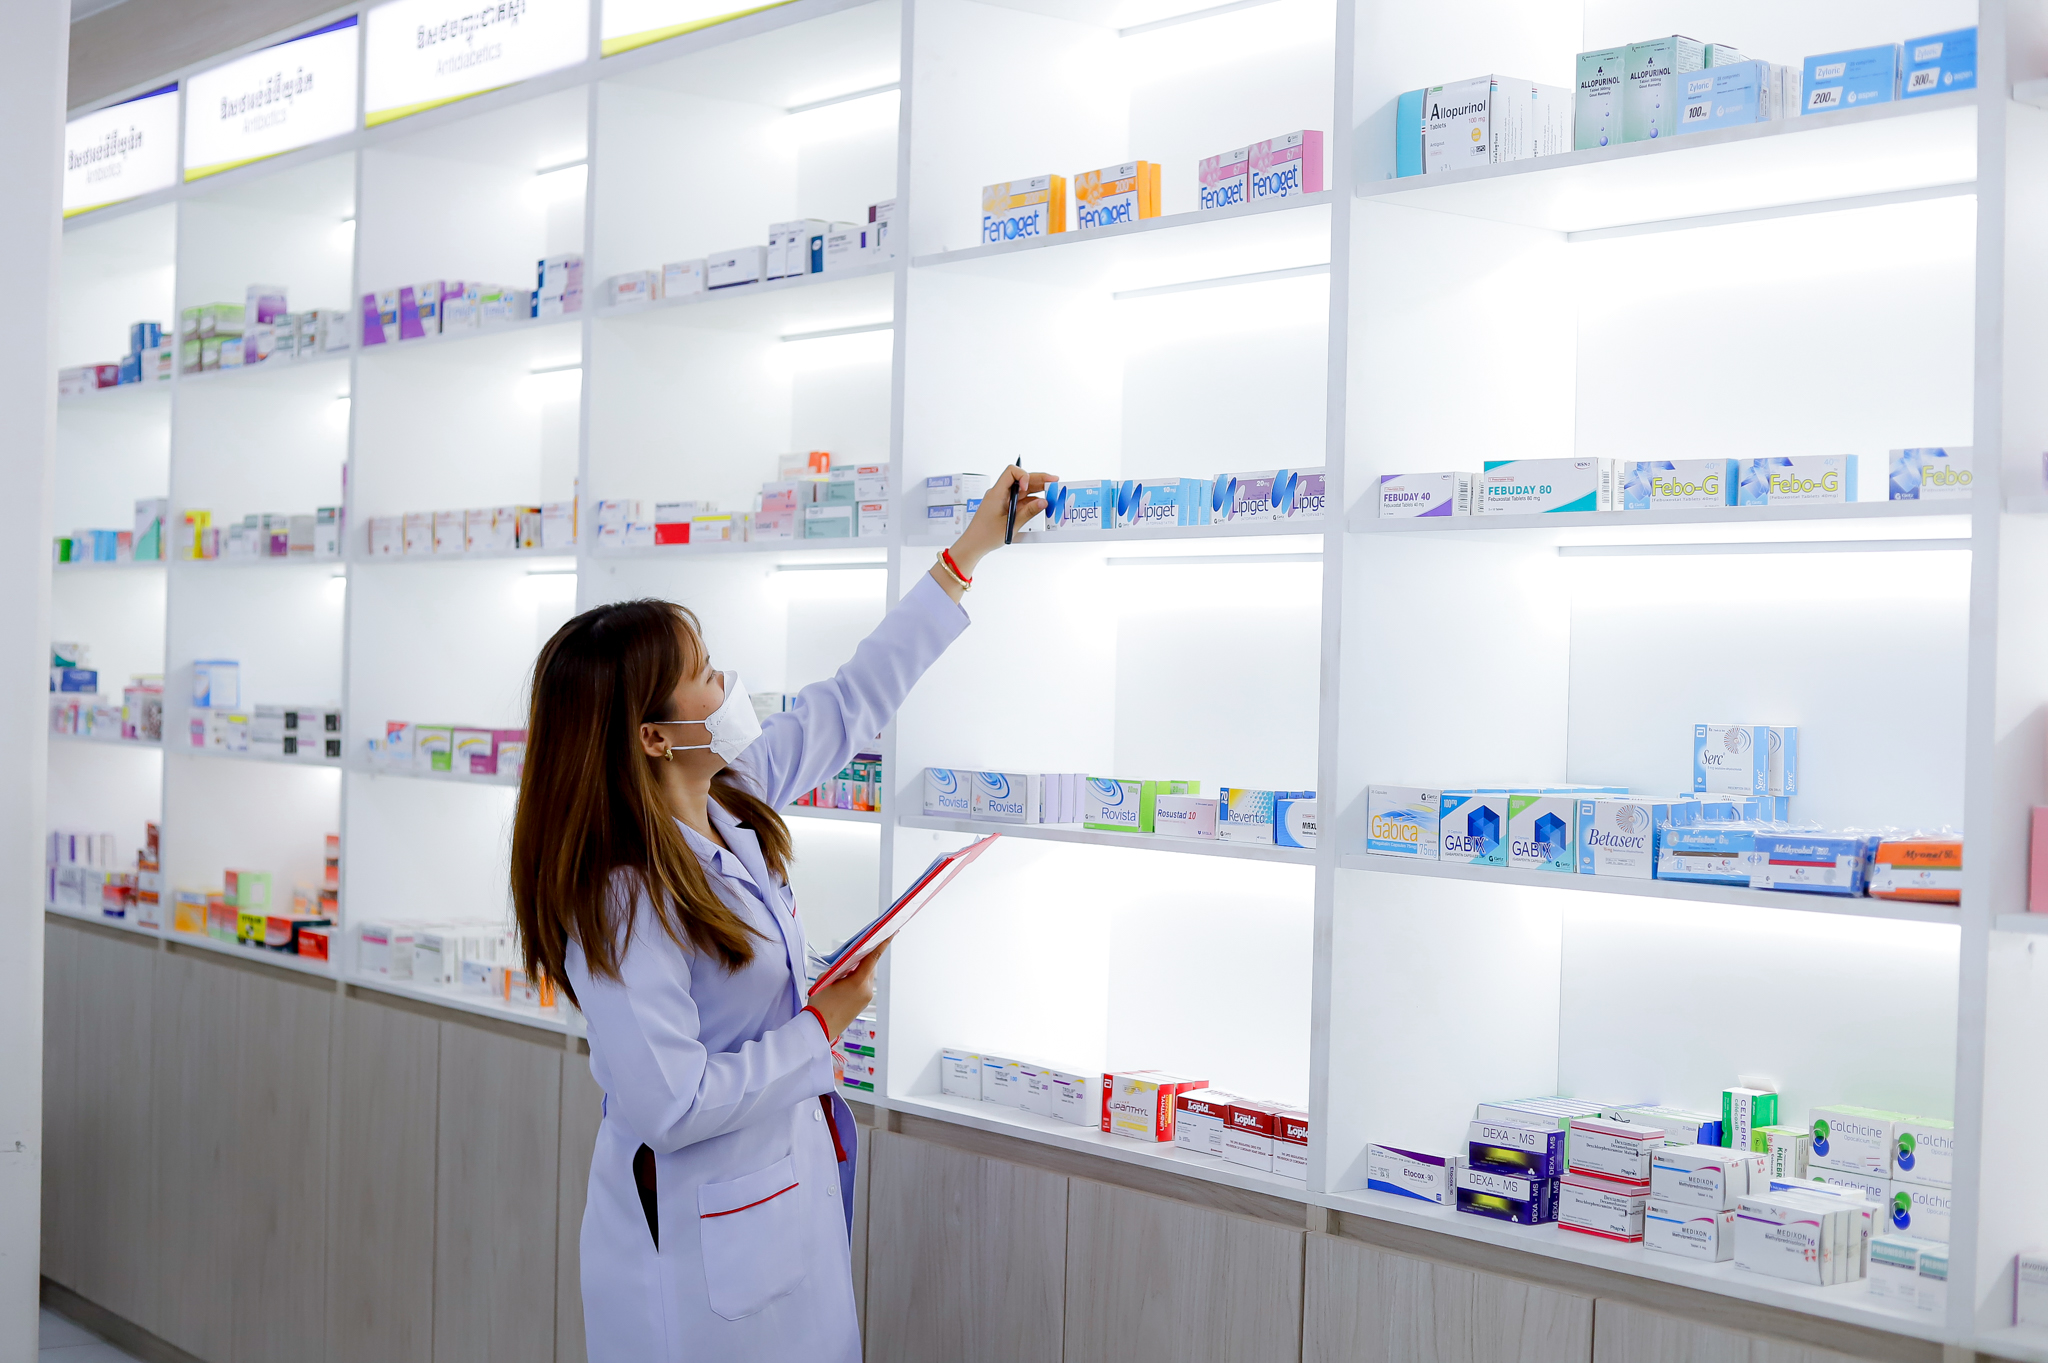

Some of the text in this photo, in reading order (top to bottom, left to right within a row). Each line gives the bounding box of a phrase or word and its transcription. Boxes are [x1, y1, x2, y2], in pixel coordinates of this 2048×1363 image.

[1630, 67, 1671, 81] ALLOPURINOL
[1817, 67, 1841, 78] Zyloric
[1580, 76, 1620, 89] ALLOPURINOL
[1689, 81, 1709, 92] Zyloric
[1858, 91, 1878, 100] aspen
[1430, 100, 1486, 121] Allopurinol
[1430, 123, 1447, 131] Tablets
[1252, 164, 1299, 198] Fenoget
[1201, 179, 1243, 210] Fenoget
[1078, 198, 1131, 230] Fenoget
[983, 209, 1040, 244] Fenoget
[1769, 472, 1838, 494] Febo-G
[1921, 464, 1973, 486] Febo
[1488, 485, 1552, 496] FEBUDAY 80
[1652, 475, 1719, 496] Febo-G
[1232, 493, 1269, 516] Lipiget
[1292, 491, 1325, 513] Lipige
[1383, 492, 1431, 502] FEBUDAY 40
[1063, 501, 1099, 524] Lipiget
[1137, 499, 1175, 521] Lipiget
[1702, 749, 1724, 765] Serc
[1755, 770, 1764, 790] Serc
[938, 795, 969, 809] Rovista
[988, 800, 1023, 814] Rovista
[1101, 807, 1136, 821] Rovista
[1157, 809, 1197, 820] Rosustad 10
[1371, 815, 1418, 842] Gabica
[1445, 835, 1486, 854] GABIX
[1588, 828, 1644, 849] Betaserc
[1419, 844, 1437, 858] 75mg
[1512, 841, 1552, 859] GABIX
[1903, 850, 1942, 860] Myonal
[1188, 1100, 1209, 1113] Lopid
[1234, 1112, 1256, 1126] Lopid
[1483, 1127, 1535, 1146] DEXA MS
[1830, 1120, 1883, 1139] Colchicine
[1549, 1136, 1556, 1150] MS
[1916, 1133, 1953, 1150] Colchic
[1469, 1173, 1518, 1192] DEXA MS
[1553, 1180, 1560, 1194] MS
[1688, 1176, 1714, 1186] MEDIXON
[1533, 1183, 1539, 1197] MS
[1912, 1192, 1951, 1209] Colchic
[1682, 1227, 1707, 1237] MEDIXON
[1777, 1229, 1815, 1246] MEDIXON 16
